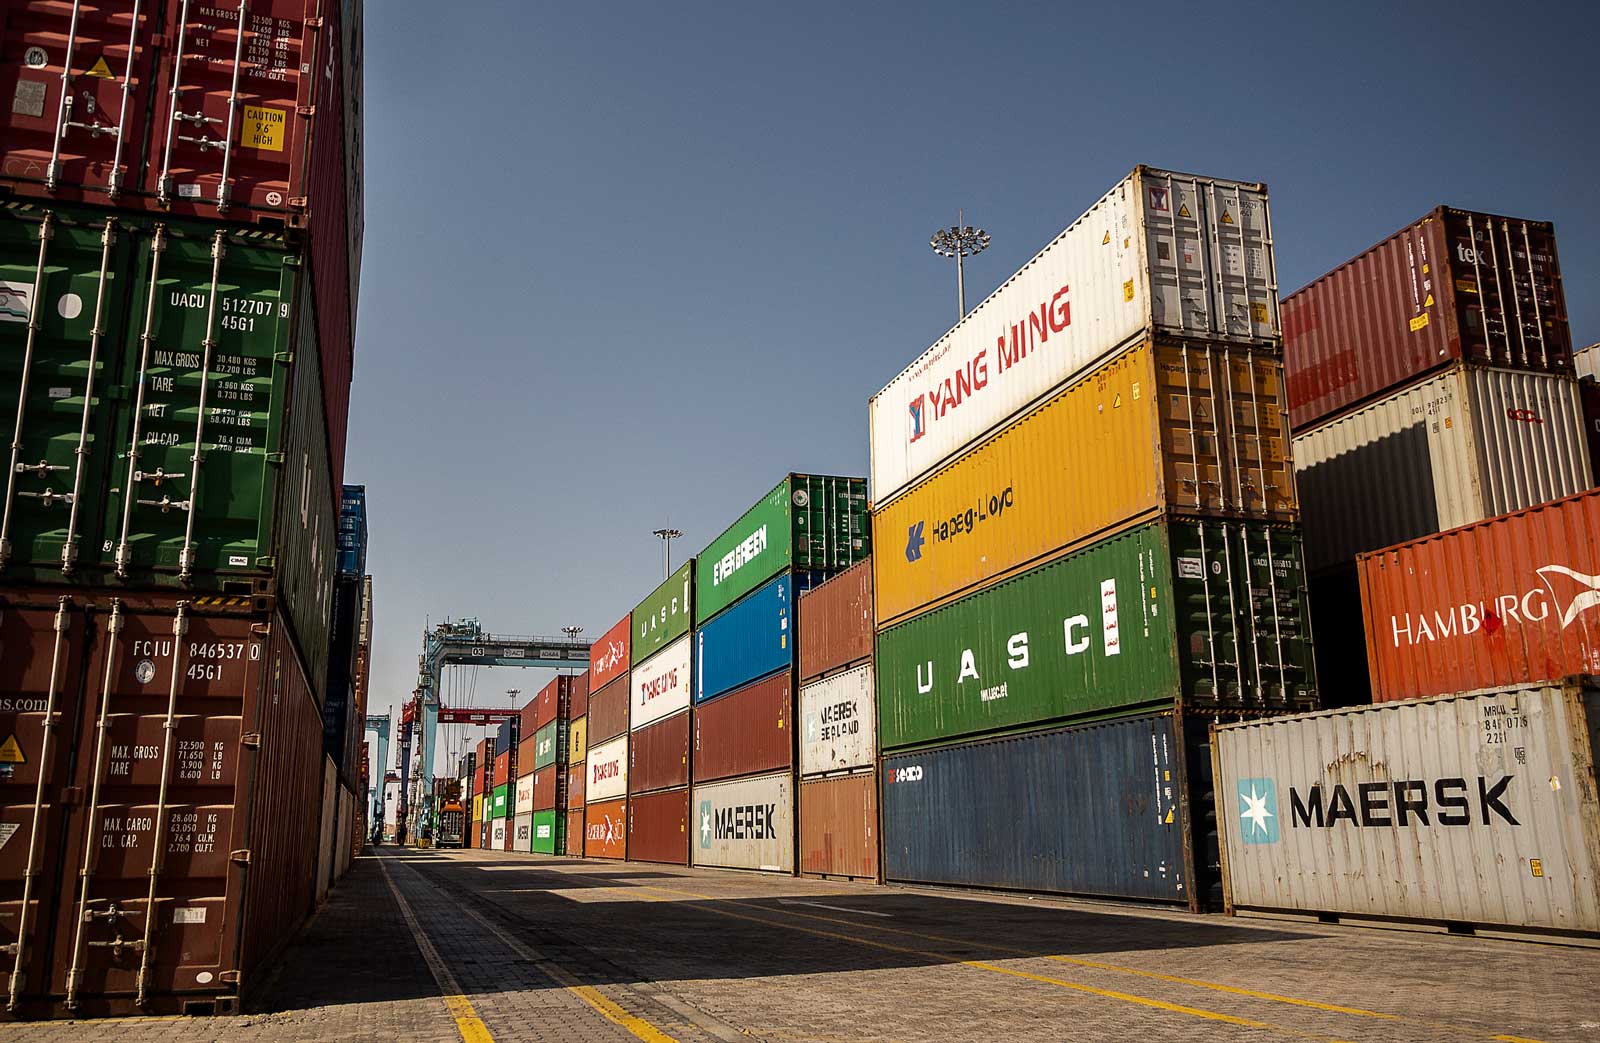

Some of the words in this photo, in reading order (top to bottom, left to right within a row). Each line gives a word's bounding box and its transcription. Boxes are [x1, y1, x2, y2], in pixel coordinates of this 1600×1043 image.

[216, 10, 238, 20] GROSS
[195, 38, 209, 47] NET
[246, 109, 283, 123] CAUTION
[252, 135, 273, 145] HIGH
[171, 292, 205, 308] UACU
[222, 298, 273, 316] 512707
[281, 303, 288, 318] 9
[221, 315, 254, 332] 45G1
[929, 348, 988, 421] YANG
[997, 285, 1071, 374] MING
[152, 376, 174, 392] TARE
[241, 383, 254, 391] KGS
[148, 403, 165, 418] NET
[932, 479, 1014, 545] Hapag-Lloyd
[713, 523, 768, 587] EVERGREEN
[1391, 588, 1549, 647] HAMBURG
[134, 640, 171, 656] FCIU
[190, 643, 244, 659] 846537
[250, 644, 259, 660] 0
[472, 648, 484, 656] 03
[188, 664, 222, 680] 45G1
[179, 741, 205, 750] 32.500
[215, 742, 224, 750] KG
[112, 746, 131, 759] MAX.
[134, 746, 159, 759] GROSS
[178, 751, 204, 760] 71.650
[213, 752, 223, 760] LB
[110, 762, 130, 775] TARE
[181, 761, 202, 769] 3.900
[212, 761, 222, 770] KG
[180, 770, 201, 779] 8.600
[211, 771, 220, 779] LB
[1289, 774, 1522, 828] MAERSK
[104, 818, 123, 831] MAX.
[126, 818, 152, 831] CARGO
[171, 814, 198, 822] 28.600
[207, 814, 217, 823] KG
[715, 803, 776, 840] MAERSK
[170, 823, 197, 832] 63.050
[207, 824, 217, 833] LB
[102, 834, 115, 848] CU.
[121, 834, 138, 848] CAP.
[174, 834, 191, 842] 76.4
[168, 843, 190, 852] 2.700
